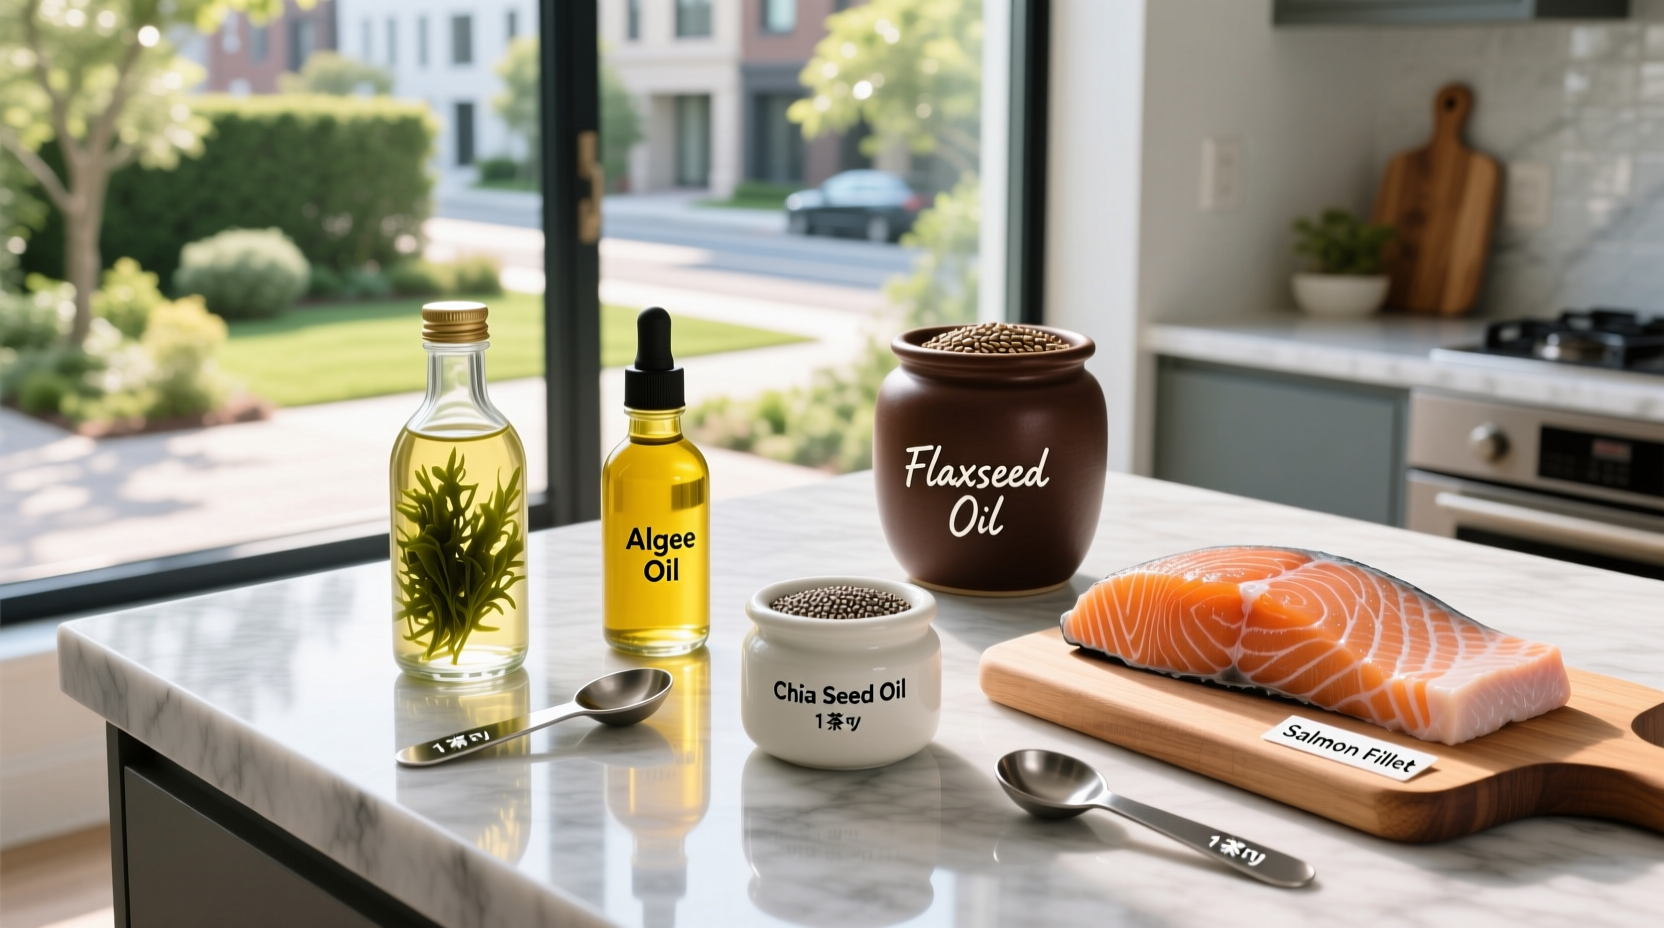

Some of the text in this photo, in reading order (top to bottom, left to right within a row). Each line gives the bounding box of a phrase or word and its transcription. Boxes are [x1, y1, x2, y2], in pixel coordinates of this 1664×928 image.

[905, 444, 1050, 489] Flaxseed
[949, 494, 1005, 538] Oil
[625, 526, 696, 557] Algee
[643, 557, 679, 583] Oil
[773, 677, 906, 704] Chia Seed Oil
[1282, 724, 1416, 773] Salmon Fillet
